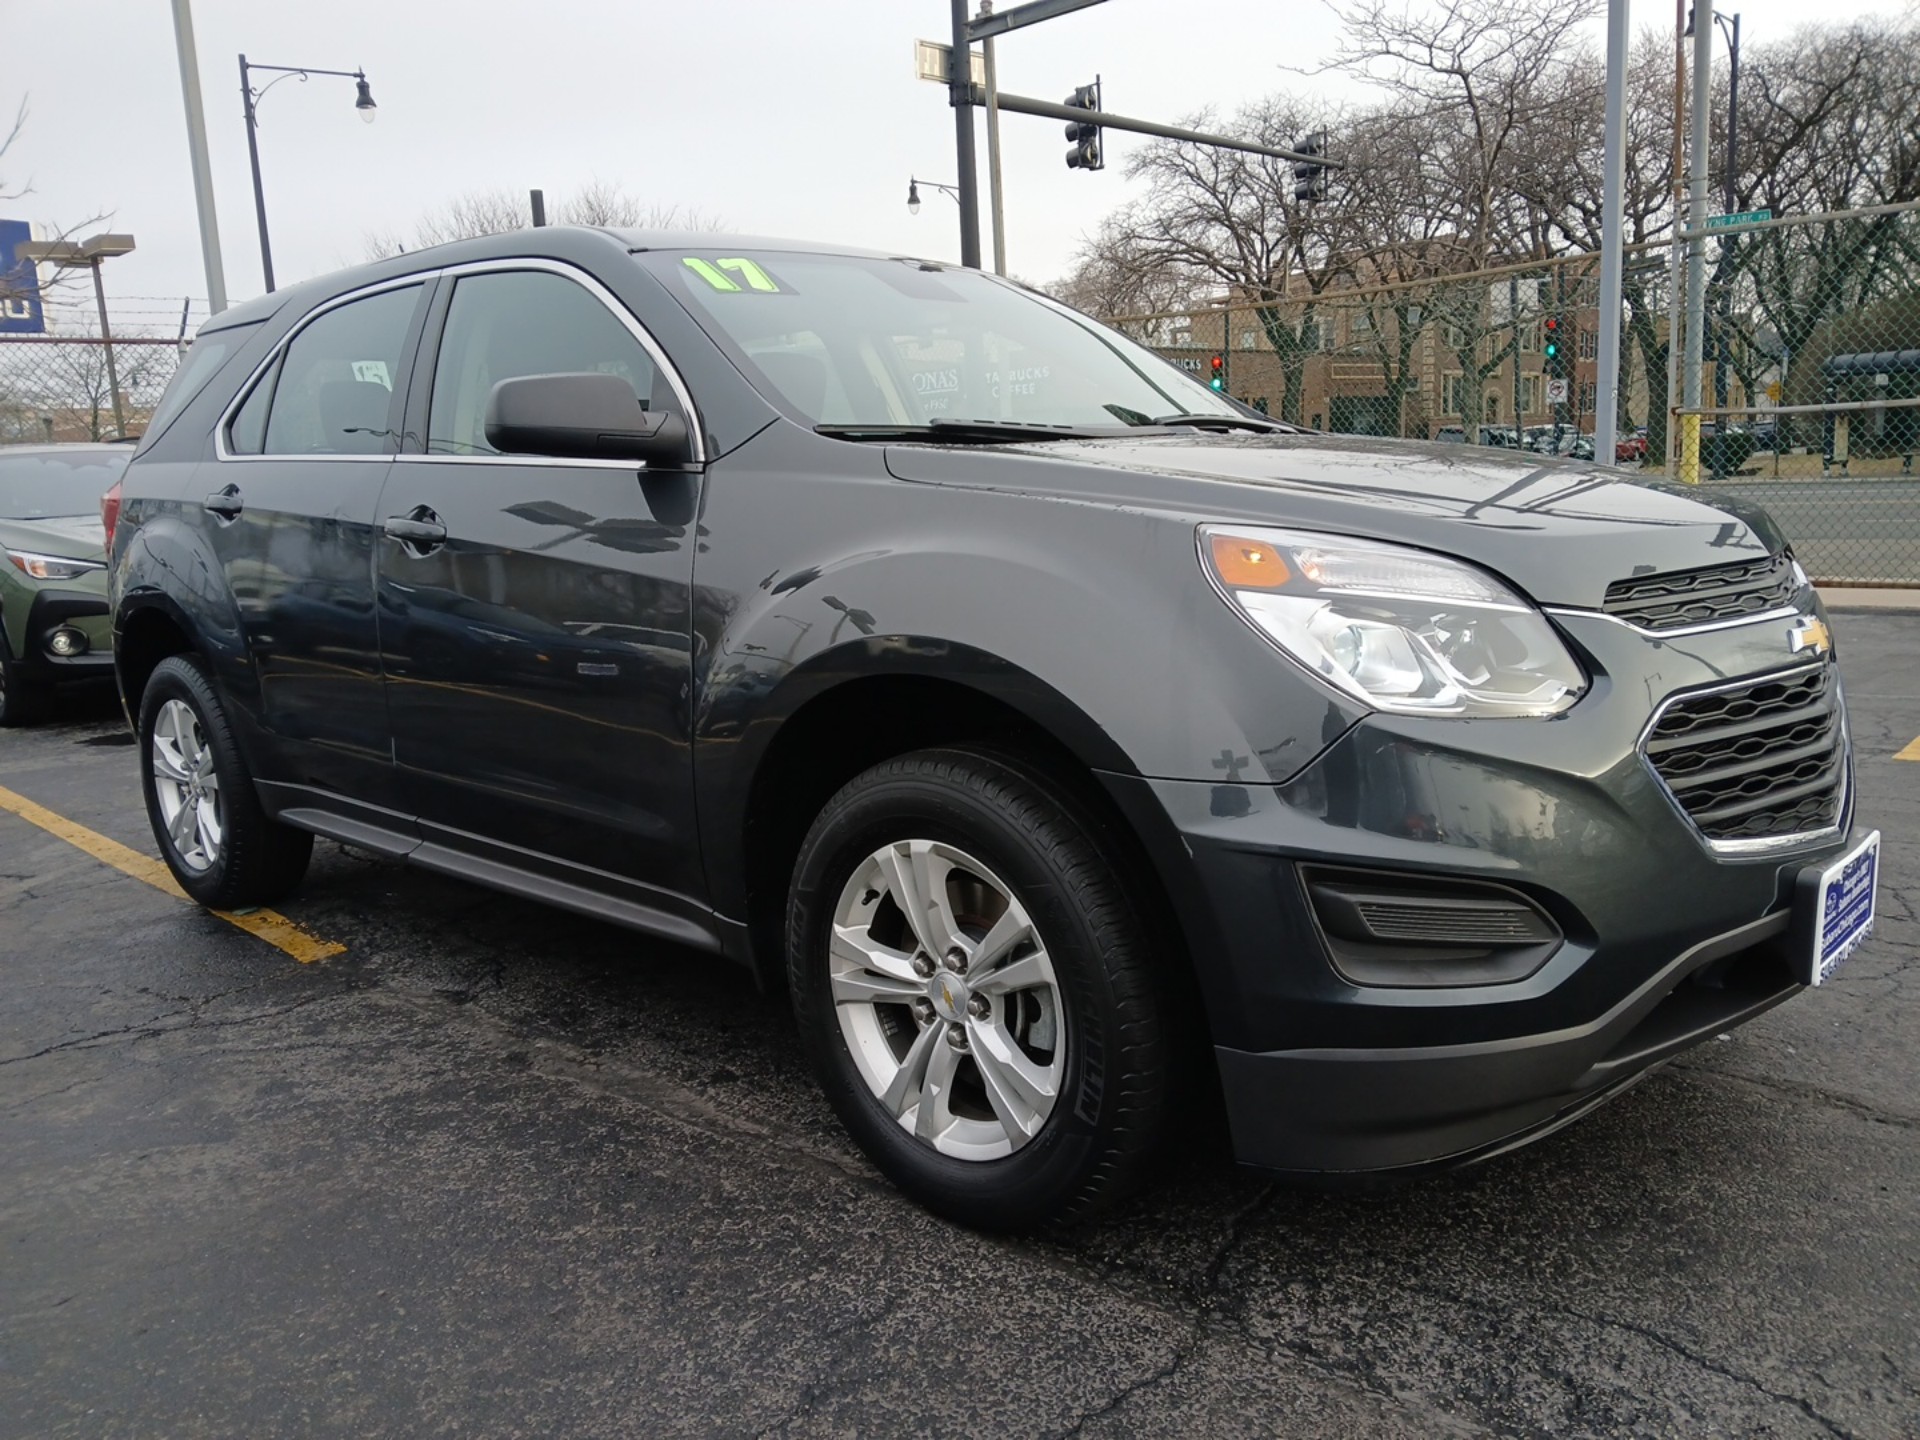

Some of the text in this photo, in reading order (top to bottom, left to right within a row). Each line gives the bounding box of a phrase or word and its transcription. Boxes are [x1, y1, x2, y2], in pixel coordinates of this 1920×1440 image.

[1730, 214, 1753, 225] PARK
[681, 257, 780, 293] 17
[991, 383, 1036, 399] CFFEE
